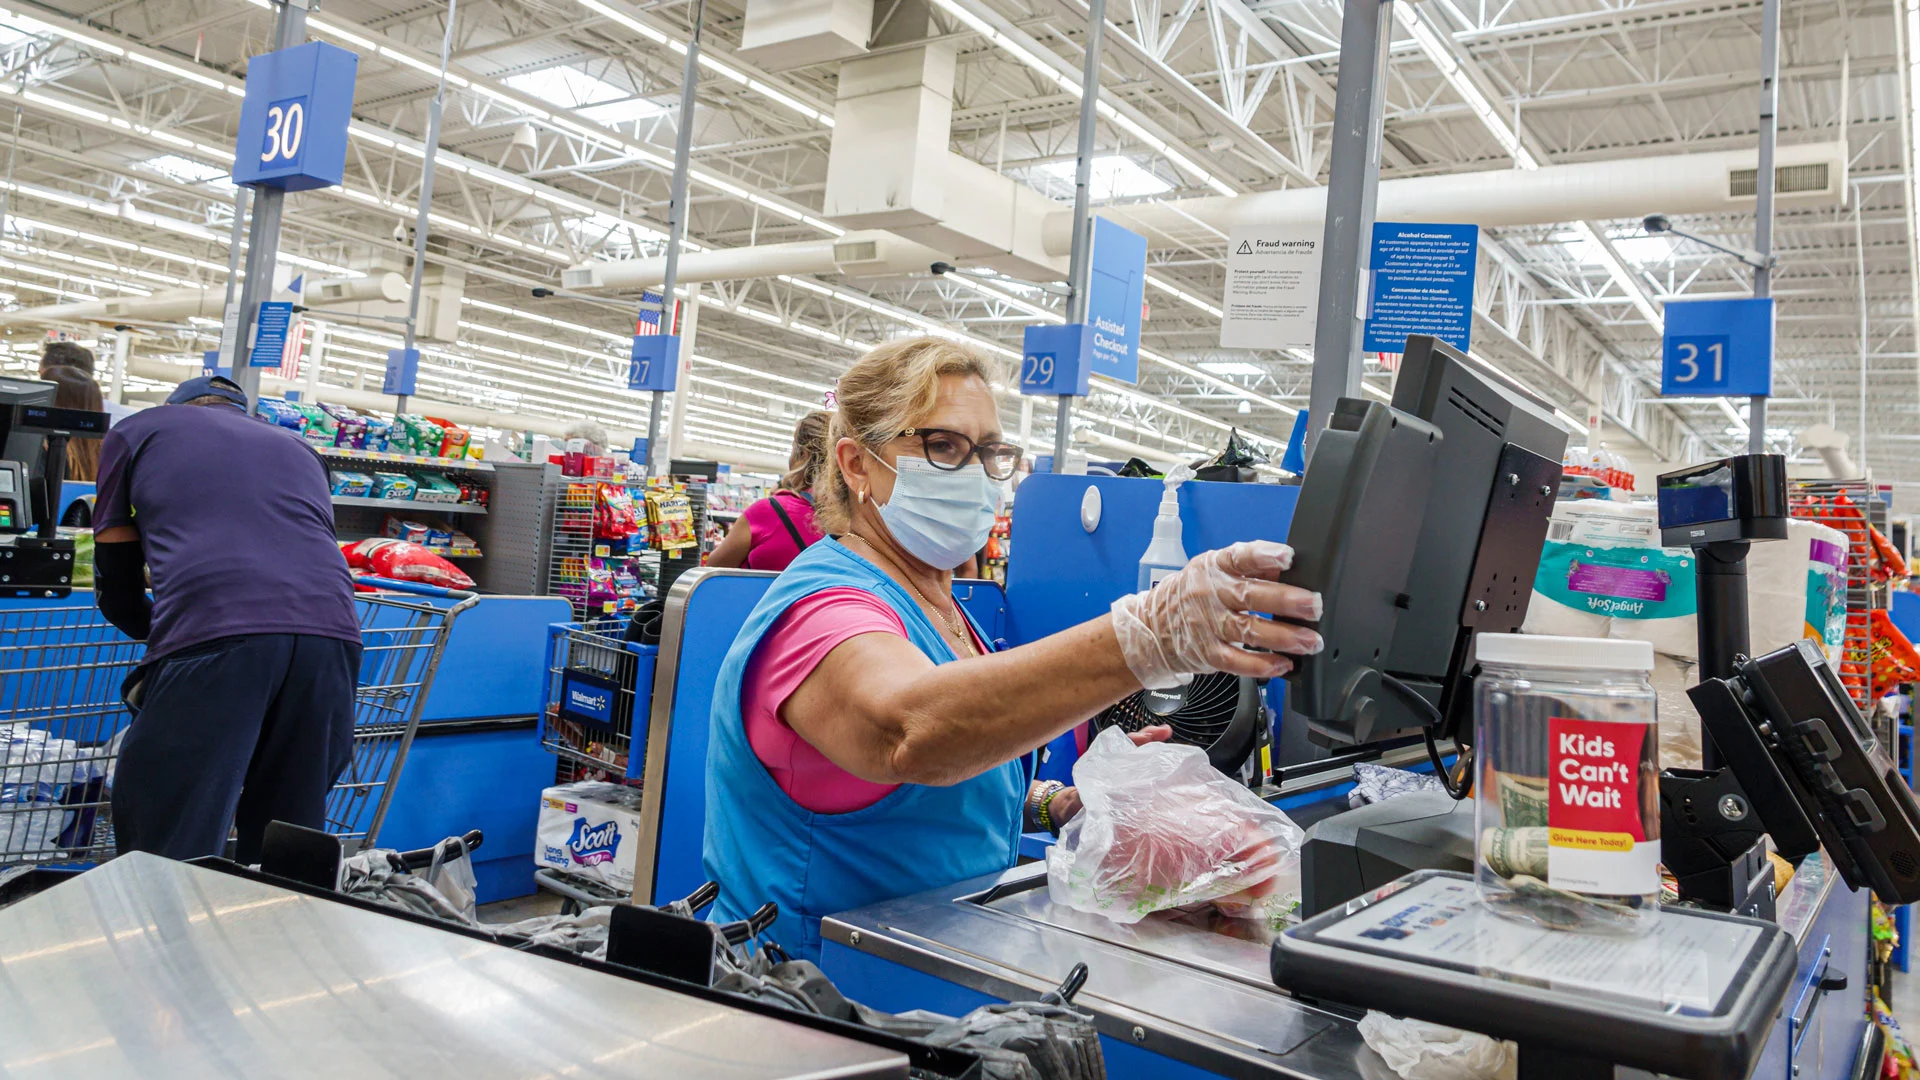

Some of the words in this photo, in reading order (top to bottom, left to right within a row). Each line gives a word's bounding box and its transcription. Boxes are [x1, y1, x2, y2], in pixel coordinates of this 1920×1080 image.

[261, 102, 303, 162] 30
[1282, 240, 1314, 248] warning
[1096, 315, 1125, 336] Assisted
[1094, 332, 1128, 355] Checkout
[631, 360, 650, 384] 27
[1024, 356, 1054, 384] 29
[1674, 343, 1722, 382] 31
[1588, 597, 1611, 611] Soft
[1609, 601, 1644, 614] Angel
[572, 690, 596, 706] Walmart
[1151, 691, 1181, 700] Honeywell
[1560, 733, 1615, 758] Kids
[1559, 758, 1628, 783] Can't
[1559, 783, 1621, 808] Wait
[572, 822, 616, 852] Scott
[1553, 833, 1573, 843] Give
[1576, 836, 1597, 845] Here
[1600, 838, 1627, 847] Today!
[546, 845, 562, 857] Long
